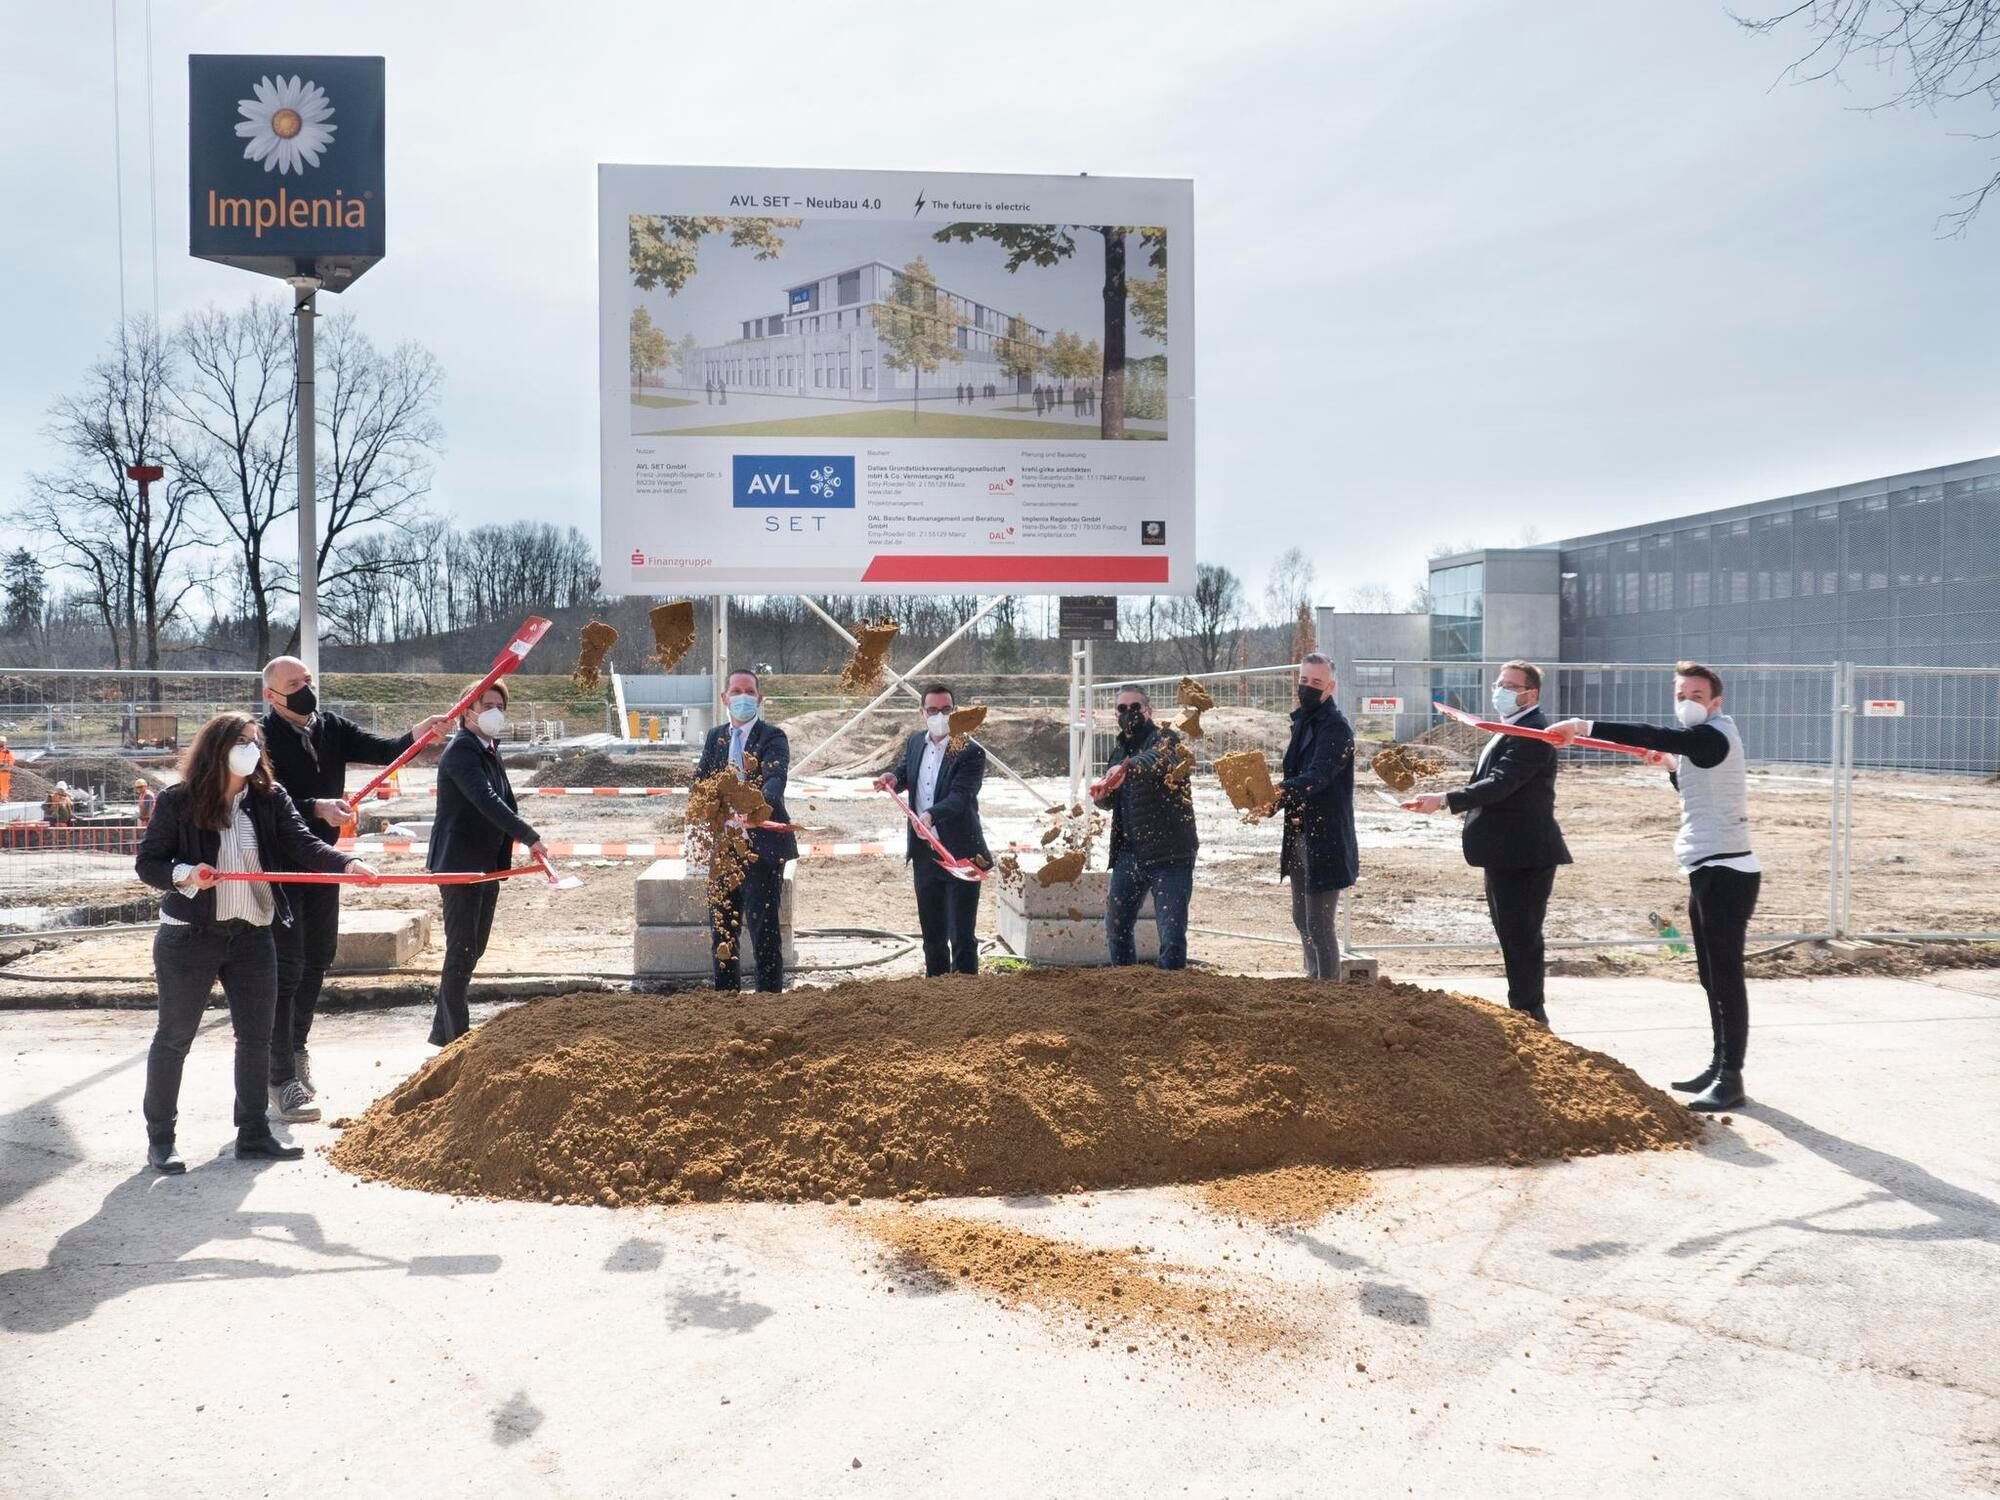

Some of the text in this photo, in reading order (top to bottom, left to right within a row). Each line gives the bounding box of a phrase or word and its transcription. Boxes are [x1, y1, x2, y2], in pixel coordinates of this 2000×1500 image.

[730, 195, 759, 207] AVL
[762, 195, 790, 208] SET
[806, 197, 858, 209] Neubau
[861, 198, 881, 210] 4.0
[932, 200, 1031, 211] The future is electric
[208, 187, 366, 238] Implenia
[747, 474, 800, 494] AVL
[989, 483, 1005, 491] DAL
[765, 516, 827, 532] SET
[975, 515, 1005, 523] Beratung
[989, 532, 1006, 540] DAL
[648, 557, 712, 568] Finanzgruppe
